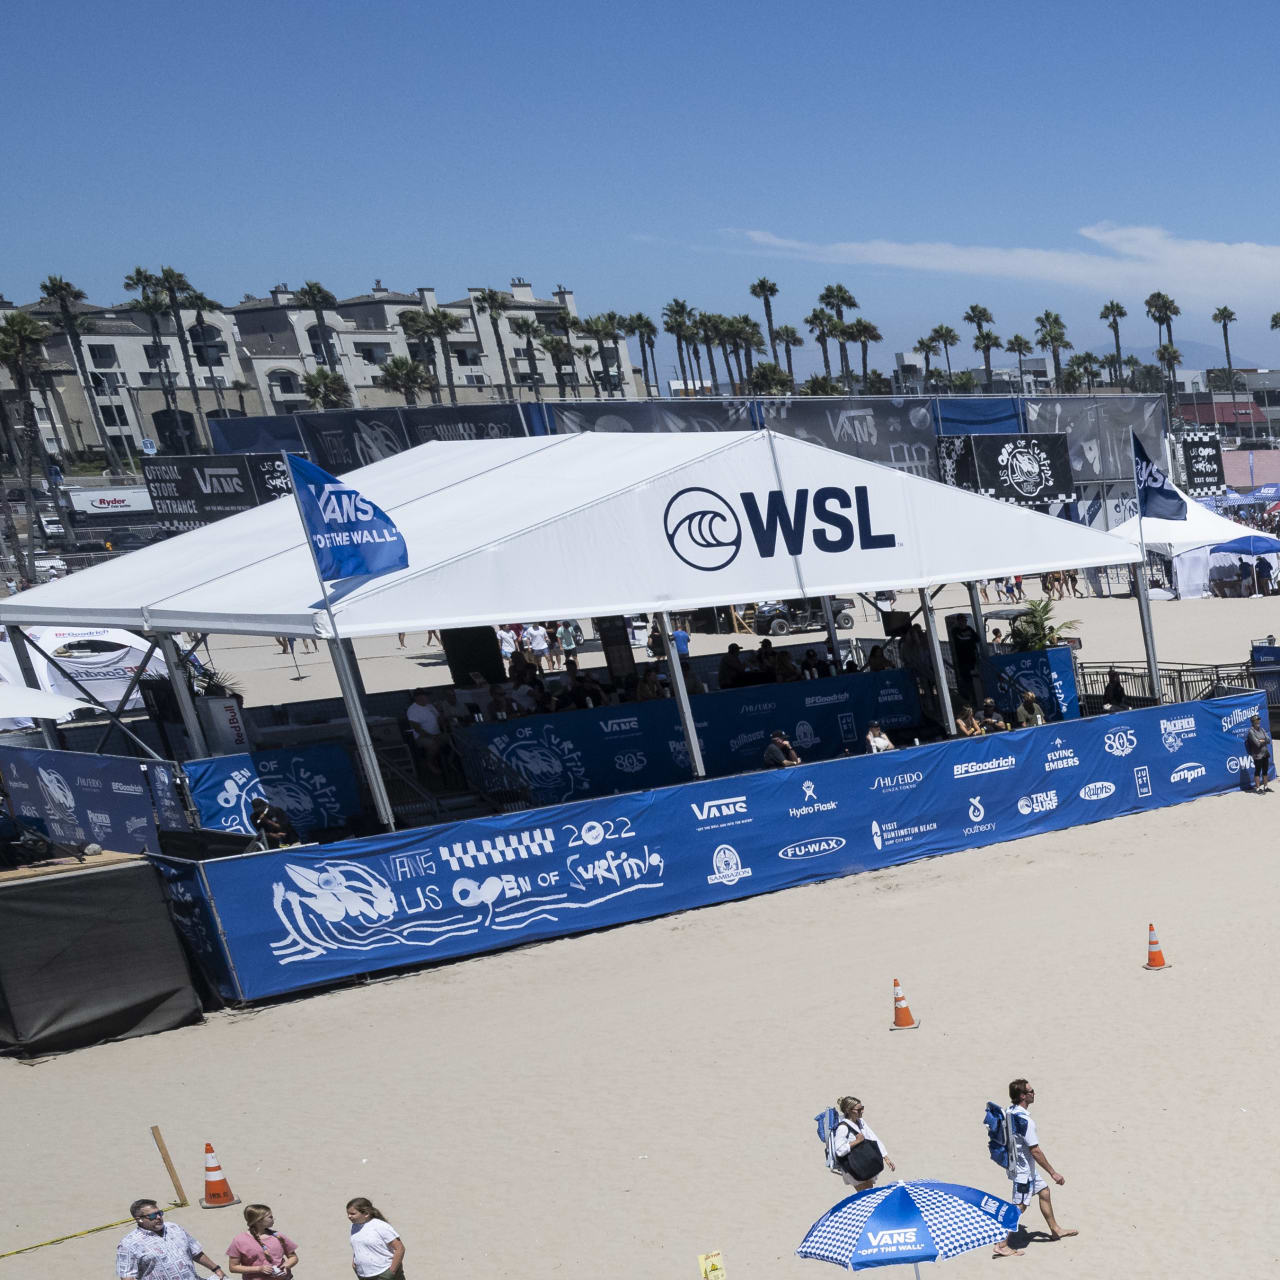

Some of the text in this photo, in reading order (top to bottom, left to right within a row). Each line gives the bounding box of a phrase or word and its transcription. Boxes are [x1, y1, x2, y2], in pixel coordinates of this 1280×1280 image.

[145, 465, 182, 480] OFFICIAL
[192, 467, 245, 493] VANS
[150, 482, 180, 497] STORE
[100, 498, 127, 507] Ryder
[155, 499, 199, 514] ENTRANCE
[308, 483, 374, 523] VANS
[740, 486, 896, 558] WSL
[599, 717, 640, 733] VANS
[1221, 704, 1260, 732] Stillhouse
[1104, 729, 1138, 754] 805
[1047, 748, 1075, 762] FLYING
[953, 755, 1016, 776] BFGoodrich
[1044, 757, 1080, 772] EMBERS
[869, 771, 924, 791] SHISEIDO
[1170, 765, 1207, 783] ampm
[1030, 789, 1058, 803] TRUE
[1083, 783, 1113, 799] Ralphs
[691, 796, 748, 820] VANS
[789, 801, 839, 818] Hydro Flask
[1032, 799, 1059, 814] SURF
[881, 821, 898, 832] VISIT
[920, 822, 938, 834] BEACH
[963, 822, 997, 837] youtheory
[382, 817, 637, 881] VANS 2022
[708, 869, 751, 884] SAMBAZON
[400, 885, 443, 914] US
[537, 871, 560, 887] OF
[866, 1227, 919, 1247] VANS
[857, 1243, 925, 1257] "OFF THE WALL"
